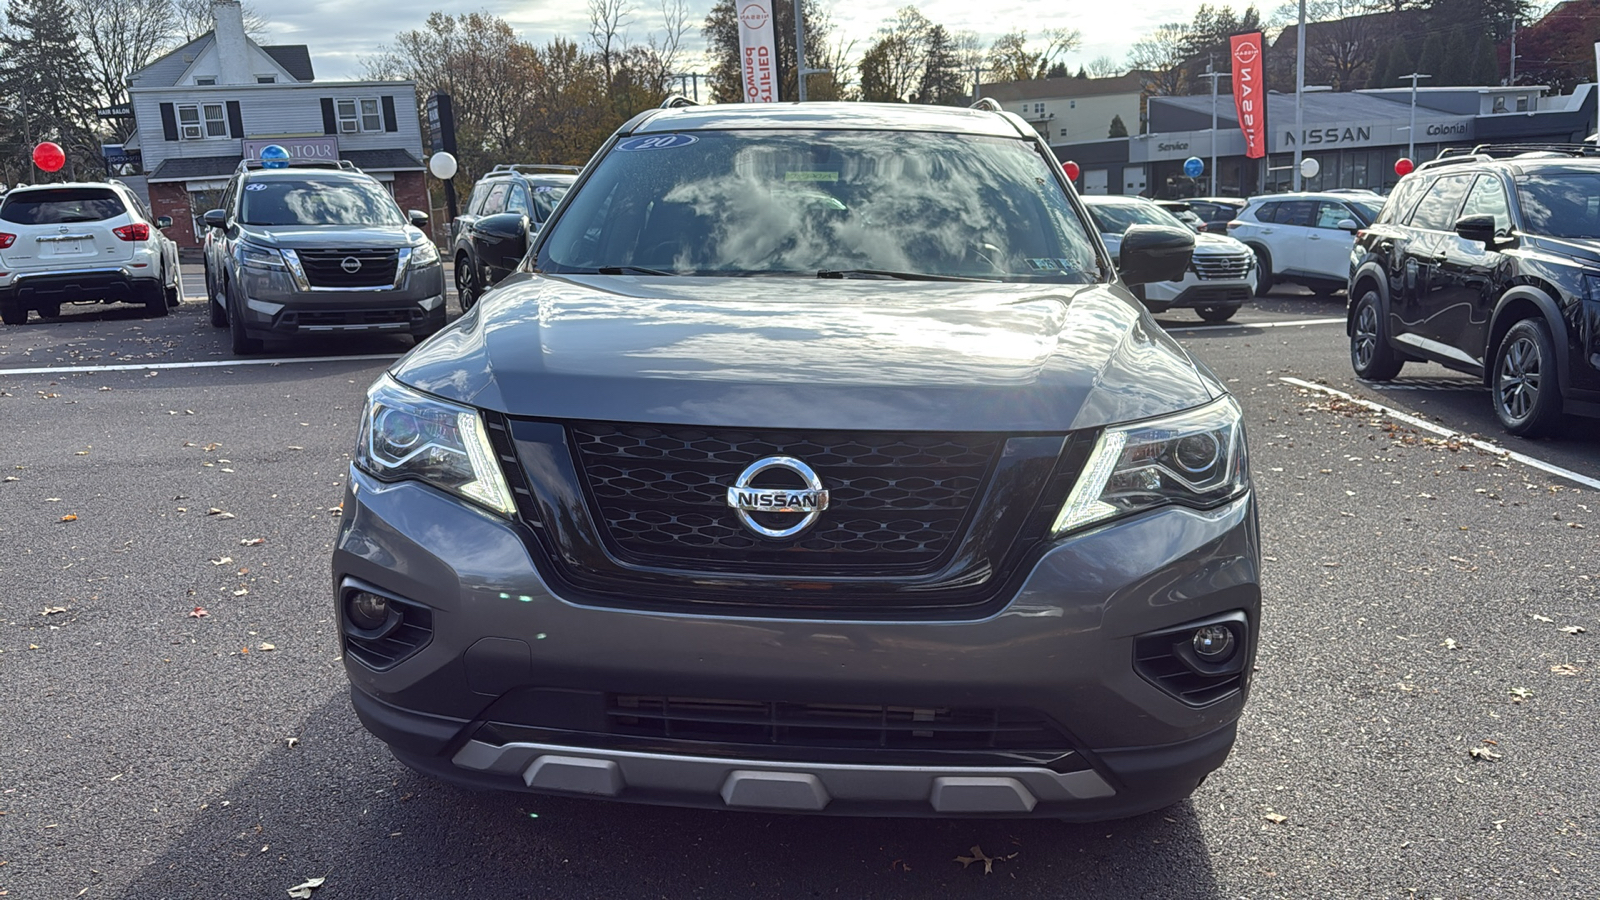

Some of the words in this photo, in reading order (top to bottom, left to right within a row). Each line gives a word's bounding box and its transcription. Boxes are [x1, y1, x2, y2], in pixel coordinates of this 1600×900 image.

[1285, 126, 1371, 146] NISSAN
[1426, 123, 1468, 136] Colonial
[634, 136, 678, 149] 20
[1158, 141, 1189, 152] Service
[259, 144, 332, 158] NTOUR
[737, 492, 818, 507] NISSAN
